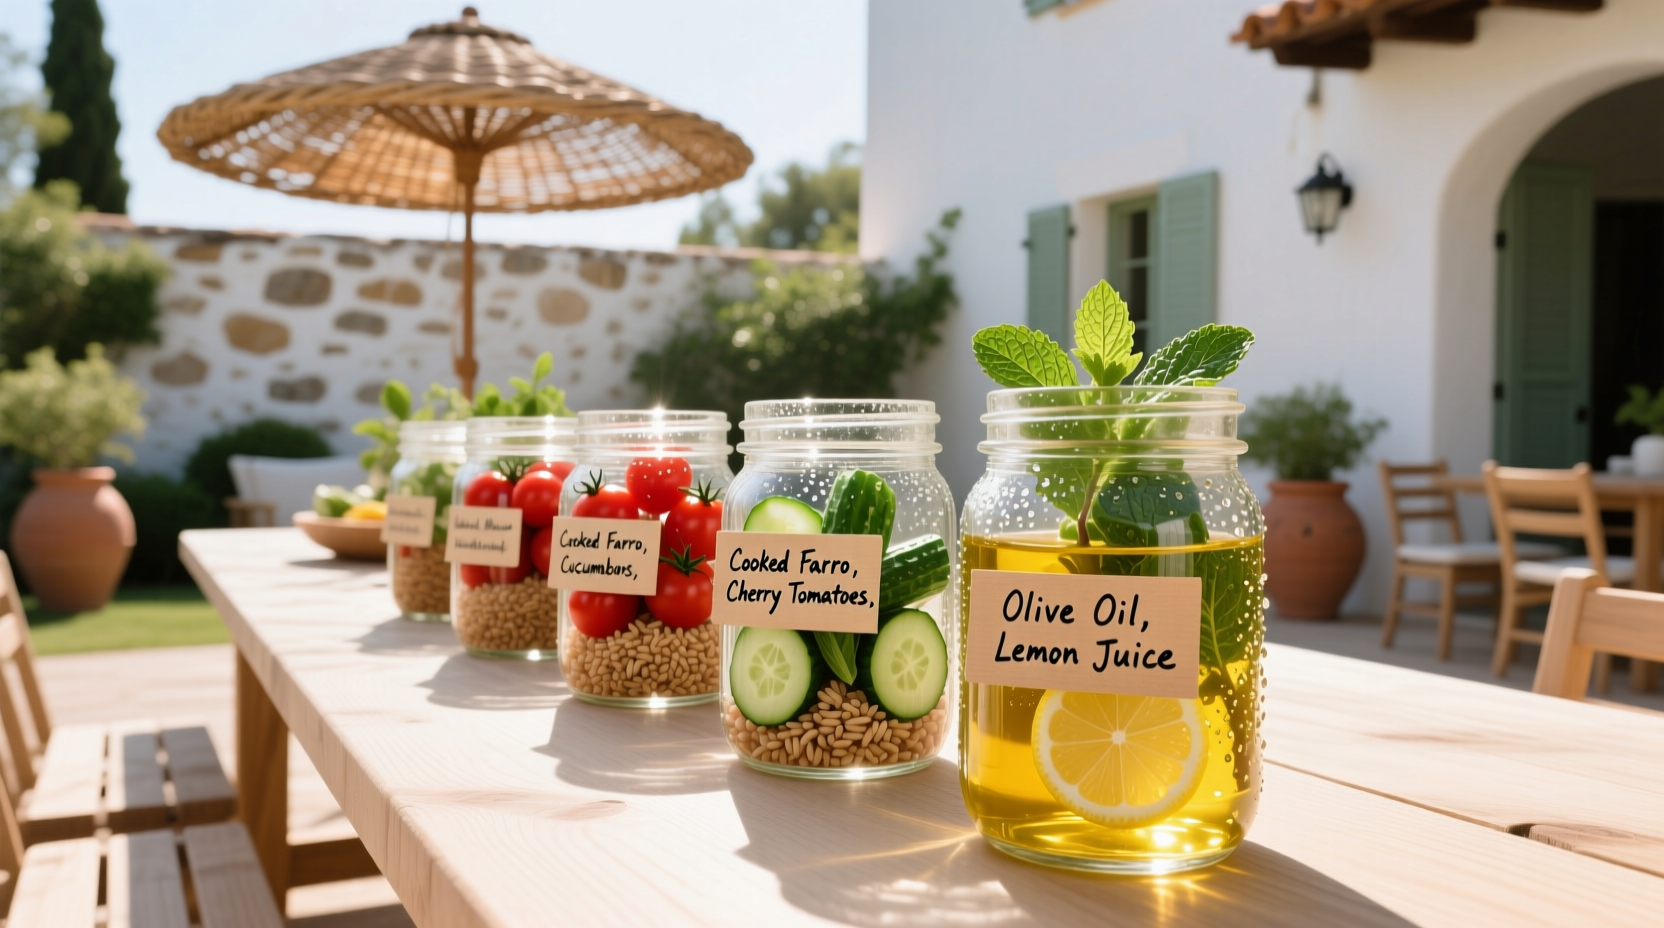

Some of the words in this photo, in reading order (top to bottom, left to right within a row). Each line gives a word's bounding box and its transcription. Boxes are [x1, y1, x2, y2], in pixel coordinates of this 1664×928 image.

[607, 531, 647, 555] Farro,
[730, 548, 790, 572] Cooked
[800, 549, 858, 578] Farro,
[727, 580, 782, 615] Cherry
[788, 581, 874, 609] Tomatoes,
[1003, 589, 1074, 624] Olive
[1094, 593, 1149, 632] Oil,
[995, 631, 1079, 664] Lemon
[1093, 639, 1176, 673] Juice
